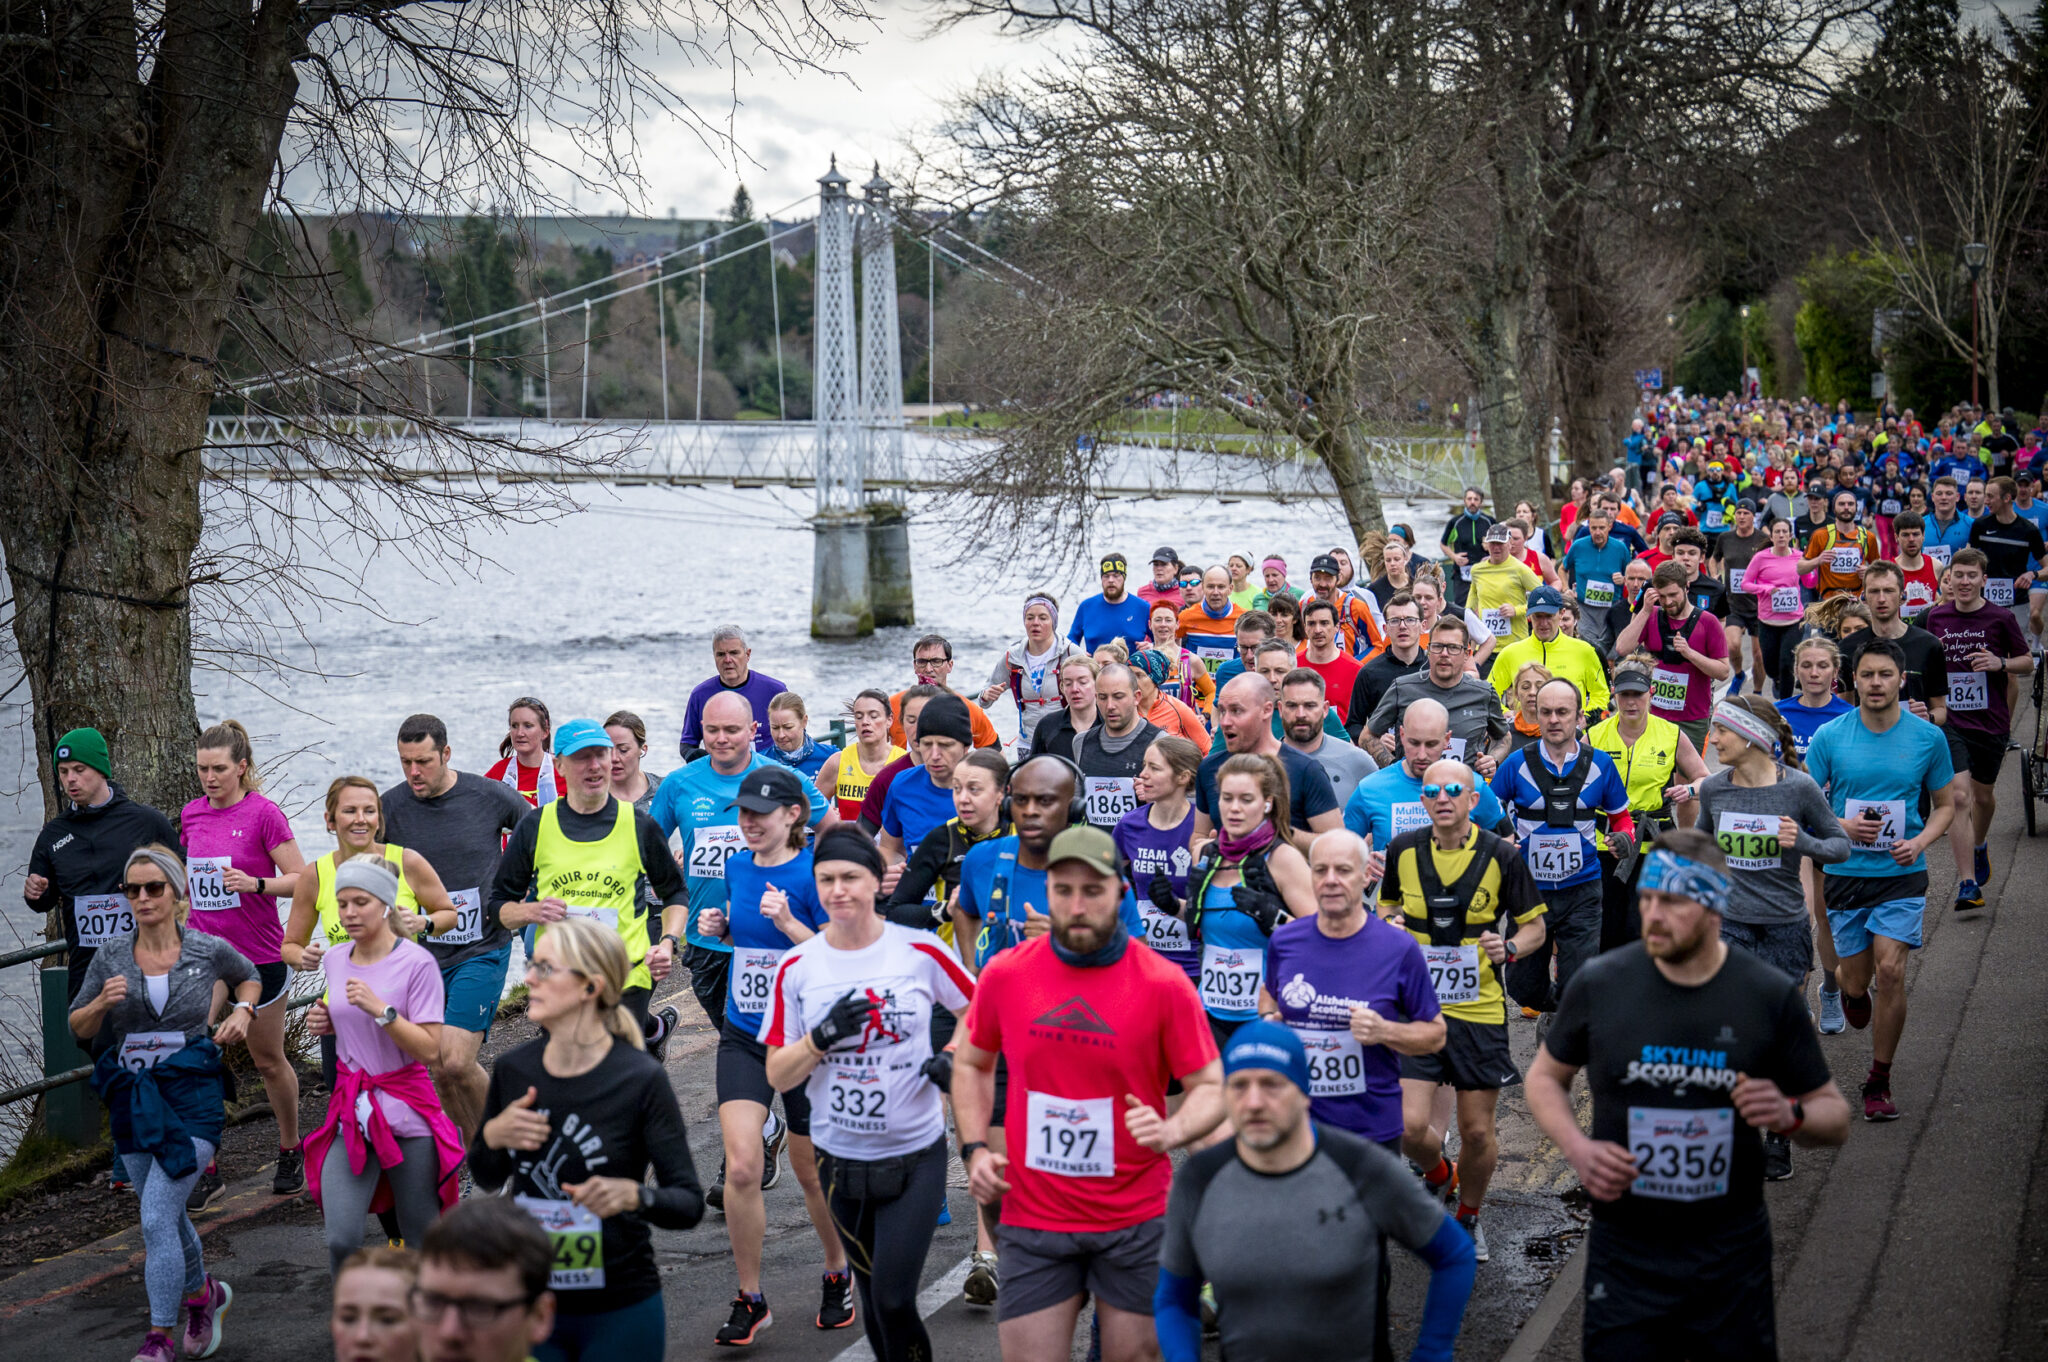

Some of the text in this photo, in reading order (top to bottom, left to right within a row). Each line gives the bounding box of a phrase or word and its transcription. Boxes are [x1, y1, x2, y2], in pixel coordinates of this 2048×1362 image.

[1831, 557, 1860, 568] 2382
[1586, 588, 1614, 602] 2963
[1773, 596, 1799, 608] 2433
[1986, 588, 2013, 600] 1982
[1651, 681, 1686, 701] 3083
[1947, 686, 1984, 702] 1841
[1087, 794, 1135, 814] 1865
[1395, 807, 1428, 816] Multip
[52, 833, 75, 852] HOKA
[1719, 833, 1780, 857] 3130
[692, 845, 750, 867] 220
[1137, 847, 1167, 861] TEAM
[1531, 851, 1581, 871] 1415
[1727, 857, 1774, 868] INVERNESS
[697, 868, 724, 877] INVER
[551, 871, 626, 896] MUIR of ORD
[562, 887, 613, 899] jogscotland
[78, 911, 134, 936] 2073
[1148, 941, 1184, 949] ERNESS
[740, 972, 775, 998] 38
[1204, 968, 1261, 996] 2037
[1207, 996, 1256, 1008] INVERNESS
[1310, 1003, 1352, 1017] Scotlan
[1315, 994, 1370, 1009] Alzheimer
[1029, 1029, 1117, 1049] NIKE TRAIL
[1640, 1045, 1728, 1070] SKYLINE
[1624, 1060, 1737, 1090] SCOTLAND
[831, 1085, 886, 1118] 332
[562, 1113, 609, 1172] GIRL
[1041, 1124, 1099, 1159] 197
[1635, 1142, 1727, 1180] 2356
